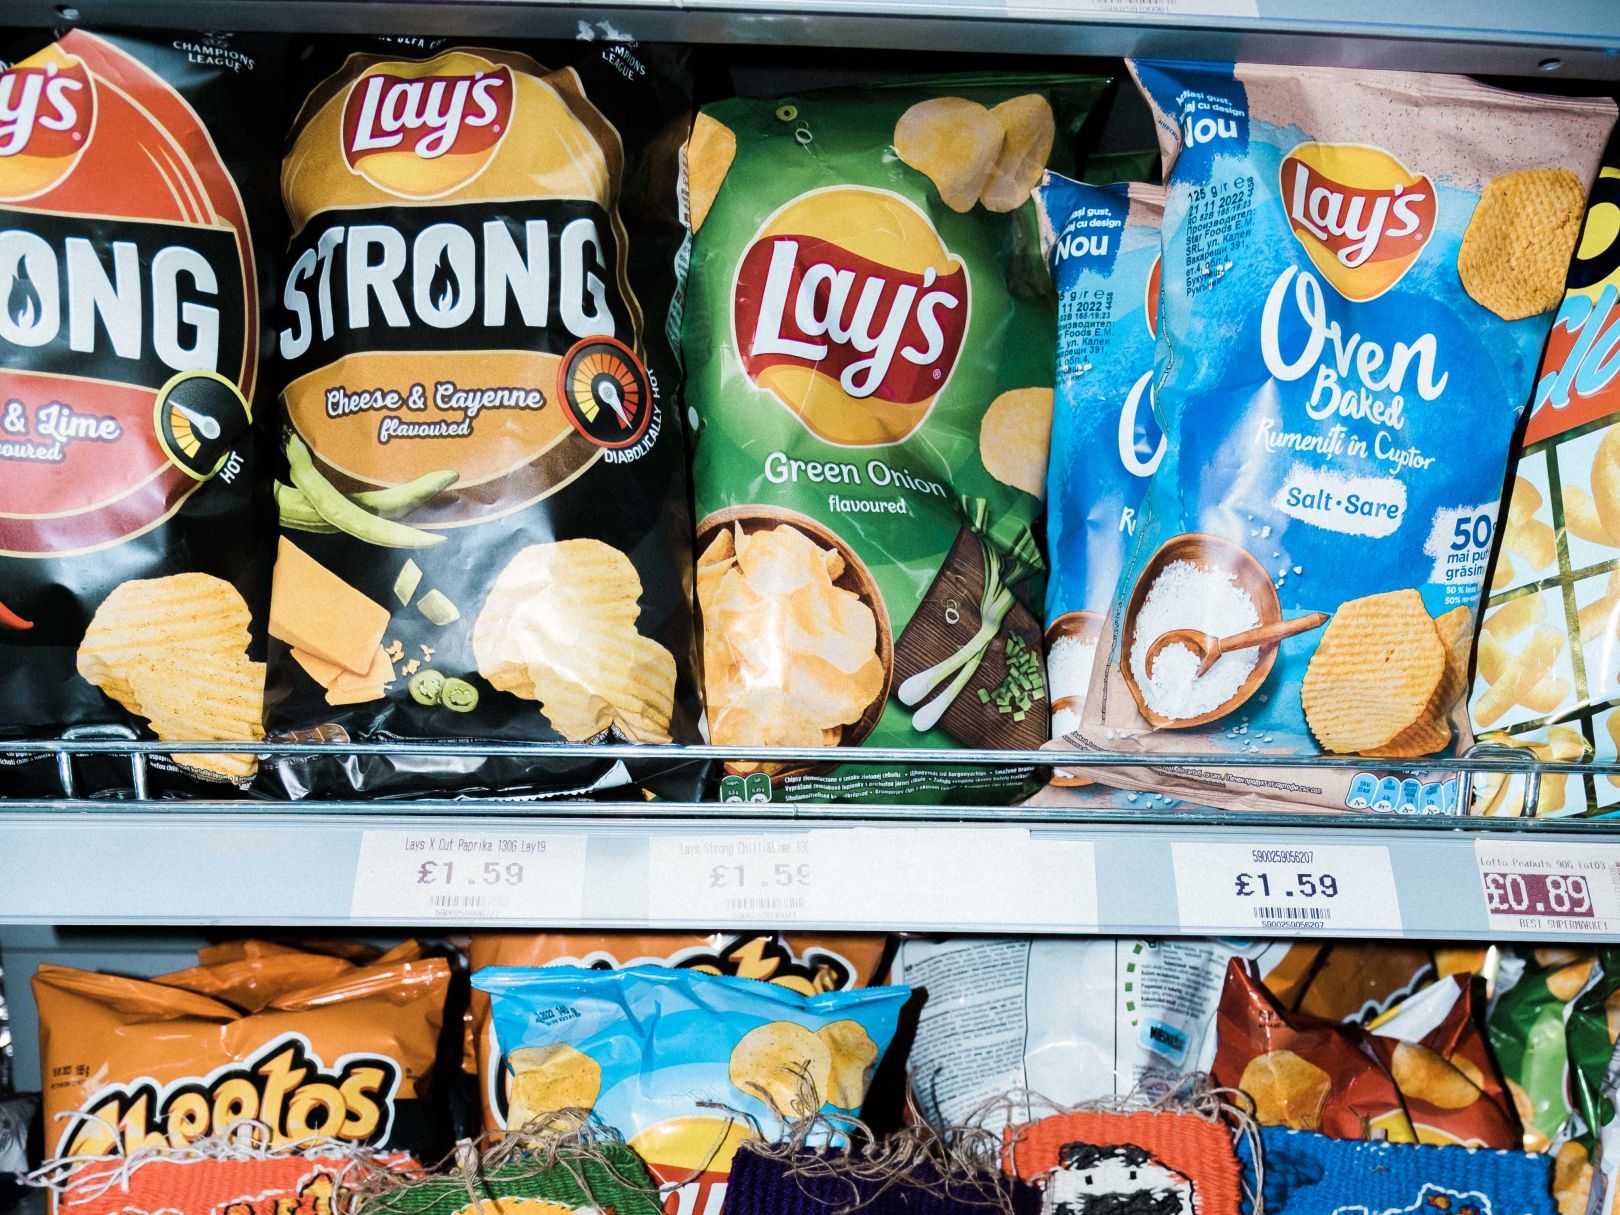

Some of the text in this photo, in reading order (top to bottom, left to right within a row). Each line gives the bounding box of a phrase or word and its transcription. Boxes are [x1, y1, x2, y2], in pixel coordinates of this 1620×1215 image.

[173, 40, 255, 71] CHAMPIONS
[188, 52, 242, 73] LEAGUE
[352, 71, 504, 158] Lay's
[1292, 162, 1426, 268] Lay's
[1055, 234, 1109, 266] Nou
[280, 218, 616, 359] STRONG
[752, 240, 958, 398] Lay's
[1076, 302, 1102, 312] 2022
[1261, 264, 1449, 401] Oven
[327, 383, 543, 416] Cheese & Cayenne
[1306, 363, 1405, 430] Baked
[4, 402, 121, 442] & Lime
[380, 418, 470, 443] flavoured
[604, 405, 663, 464] DIABOLICALLY
[219, 451, 245, 485] HOT
[1374, 431, 1436, 476] Cuptor
[765, 452, 947, 499] Green Onion
[828, 494, 907, 514] flavoured
[1450, 514, 1497, 551] 50
[1447, 550, 1470, 563] mai
[438, 838, 453, 851] Cut
[458, 838, 493, 853] Paprika
[1252, 850, 1314, 864] 5900259056207
[416, 860, 524, 886] £1.59
[710, 863, 810, 887] £1.59
[1235, 873, 1339, 898] £1.59
[1485, 873, 1591, 913] £0.89
